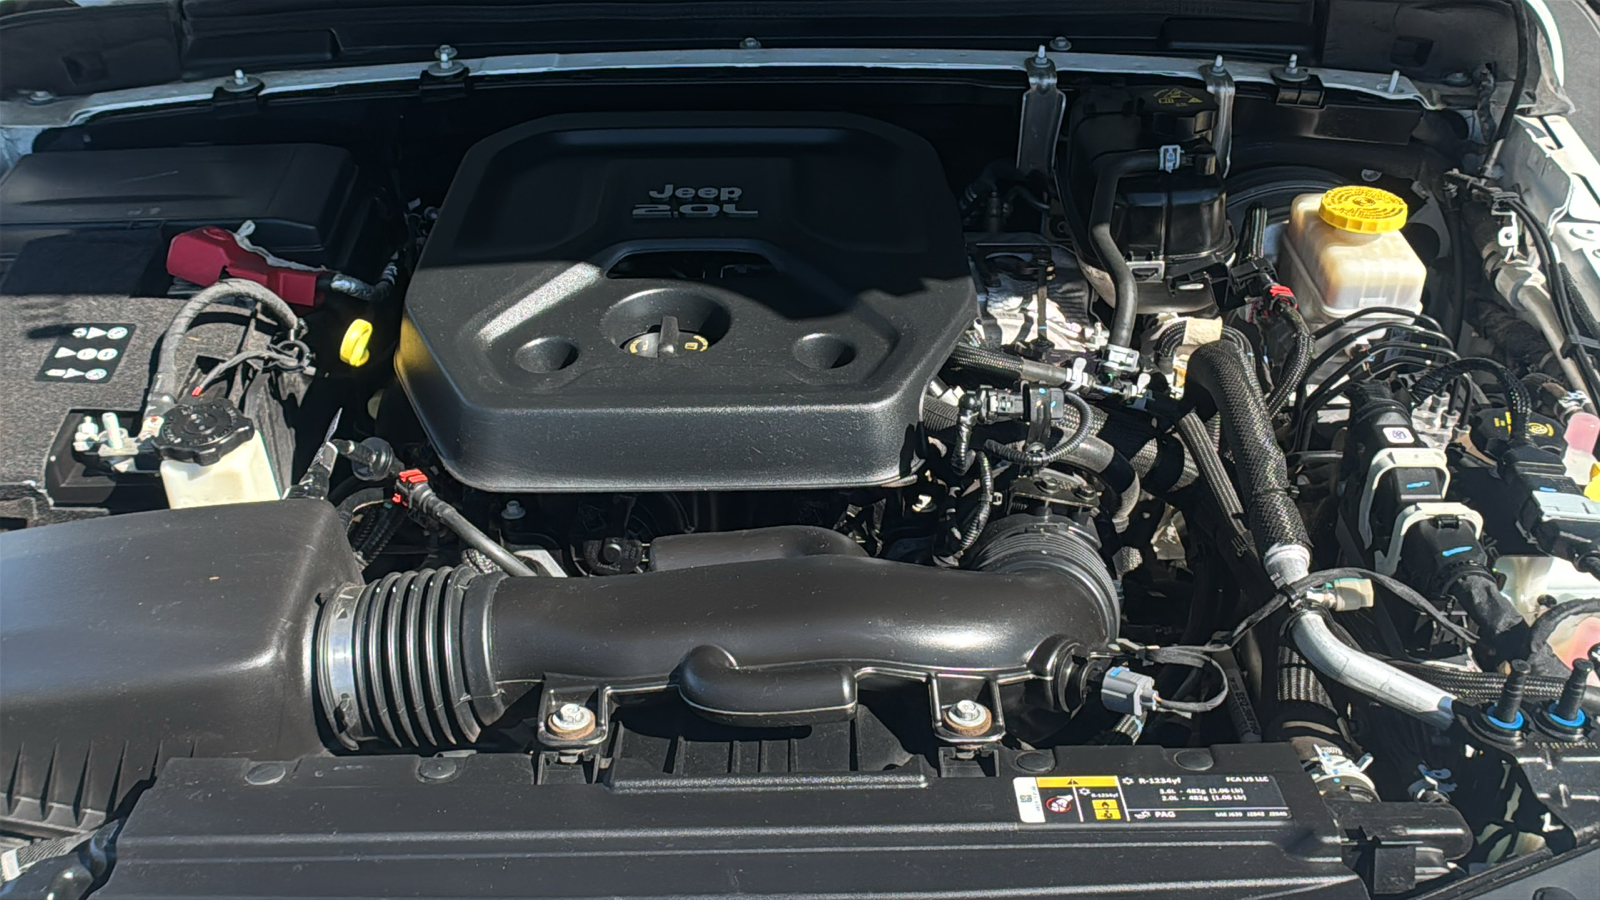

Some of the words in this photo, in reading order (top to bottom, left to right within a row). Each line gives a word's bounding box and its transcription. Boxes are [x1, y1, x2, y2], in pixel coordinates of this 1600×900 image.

[648, 184, 742, 201] Jeep
[632, 203, 759, 218] 2.0L
[1138, 777, 1181, 785] R-1234yf
